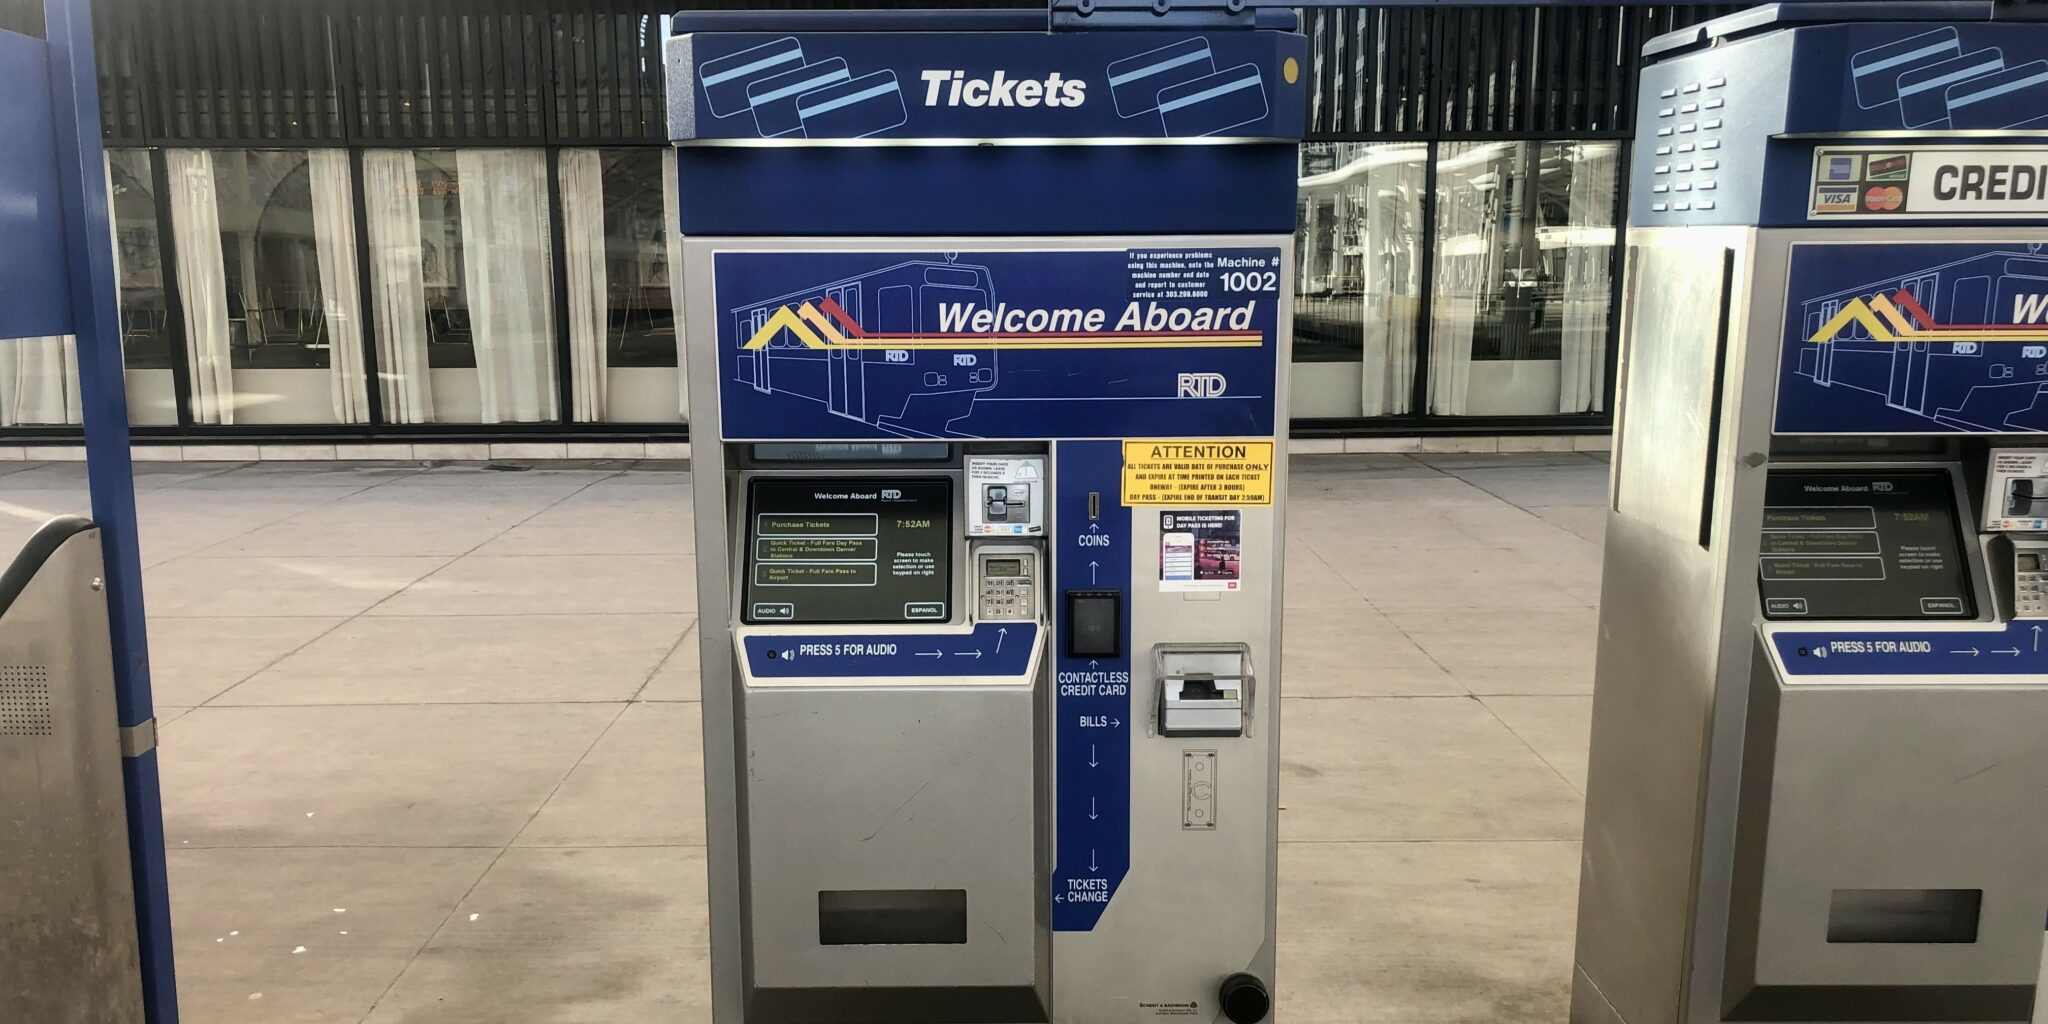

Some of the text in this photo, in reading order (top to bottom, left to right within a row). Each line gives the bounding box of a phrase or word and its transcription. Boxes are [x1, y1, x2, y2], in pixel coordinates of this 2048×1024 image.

[920, 69, 1088, 108] Tickets
[1933, 164, 2048, 200] CREDI
[1823, 194, 1851, 204] VISA
[1865, 195, 1904, 204] MasterCard
[1217, 256, 1279, 268] Machine #
[1220, 272, 1276, 292] 1002
[2012, 294, 2048, 324] W
[938, 300, 1256, 333] Welcome Aboard
[1952, 342, 1977, 354] RTD
[2022, 345, 2047, 358] RTD
[885, 350, 909, 362] RTD
[953, 354, 977, 367] RTD
[1177, 372, 1226, 398] RTD
[1150, 445, 1246, 458] ATTENTION
[1872, 482, 1894, 492] RTD
[881, 489, 902, 499] RTD
[1078, 534, 1110, 547] COINS
[800, 644, 897, 656] PRESS 5 FOR AUDIO
[1830, 641, 1931, 653] PRESS 5 FOR AUDIO
[1058, 672, 1129, 684] CONTACTLESS
[1060, 684, 1126, 696] CREDIT CARD
[1080, 716, 1107, 727] BILLS
[1068, 879, 1108, 890] TICKETS
[1068, 891, 1108, 902] CHANGE
